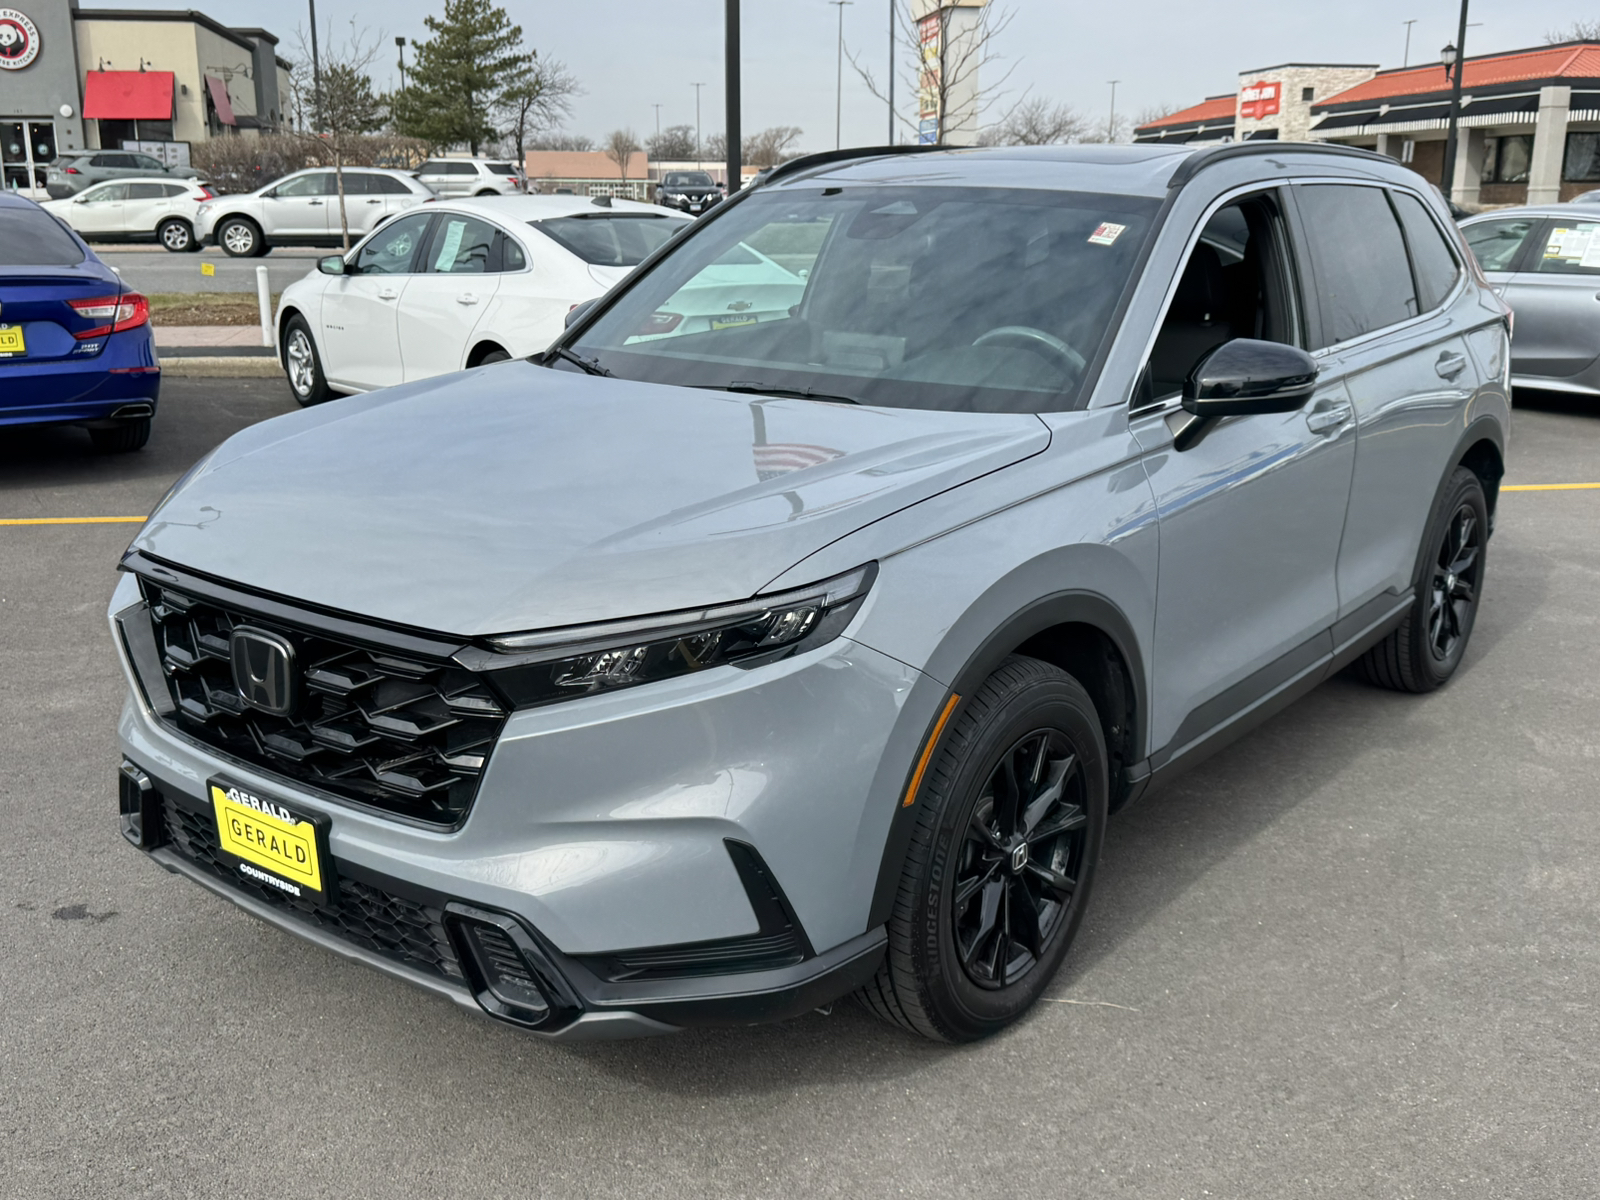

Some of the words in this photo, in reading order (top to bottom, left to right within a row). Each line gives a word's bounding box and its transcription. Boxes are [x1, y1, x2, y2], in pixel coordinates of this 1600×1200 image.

[3, 11, 36, 36] EXPRESS
[12, 47, 35, 66] KITCHEN
[230, 788, 290, 821] GERALD
[231, 818, 306, 863] GERALD
[239, 863, 301, 896] COUNTRYSIDE
